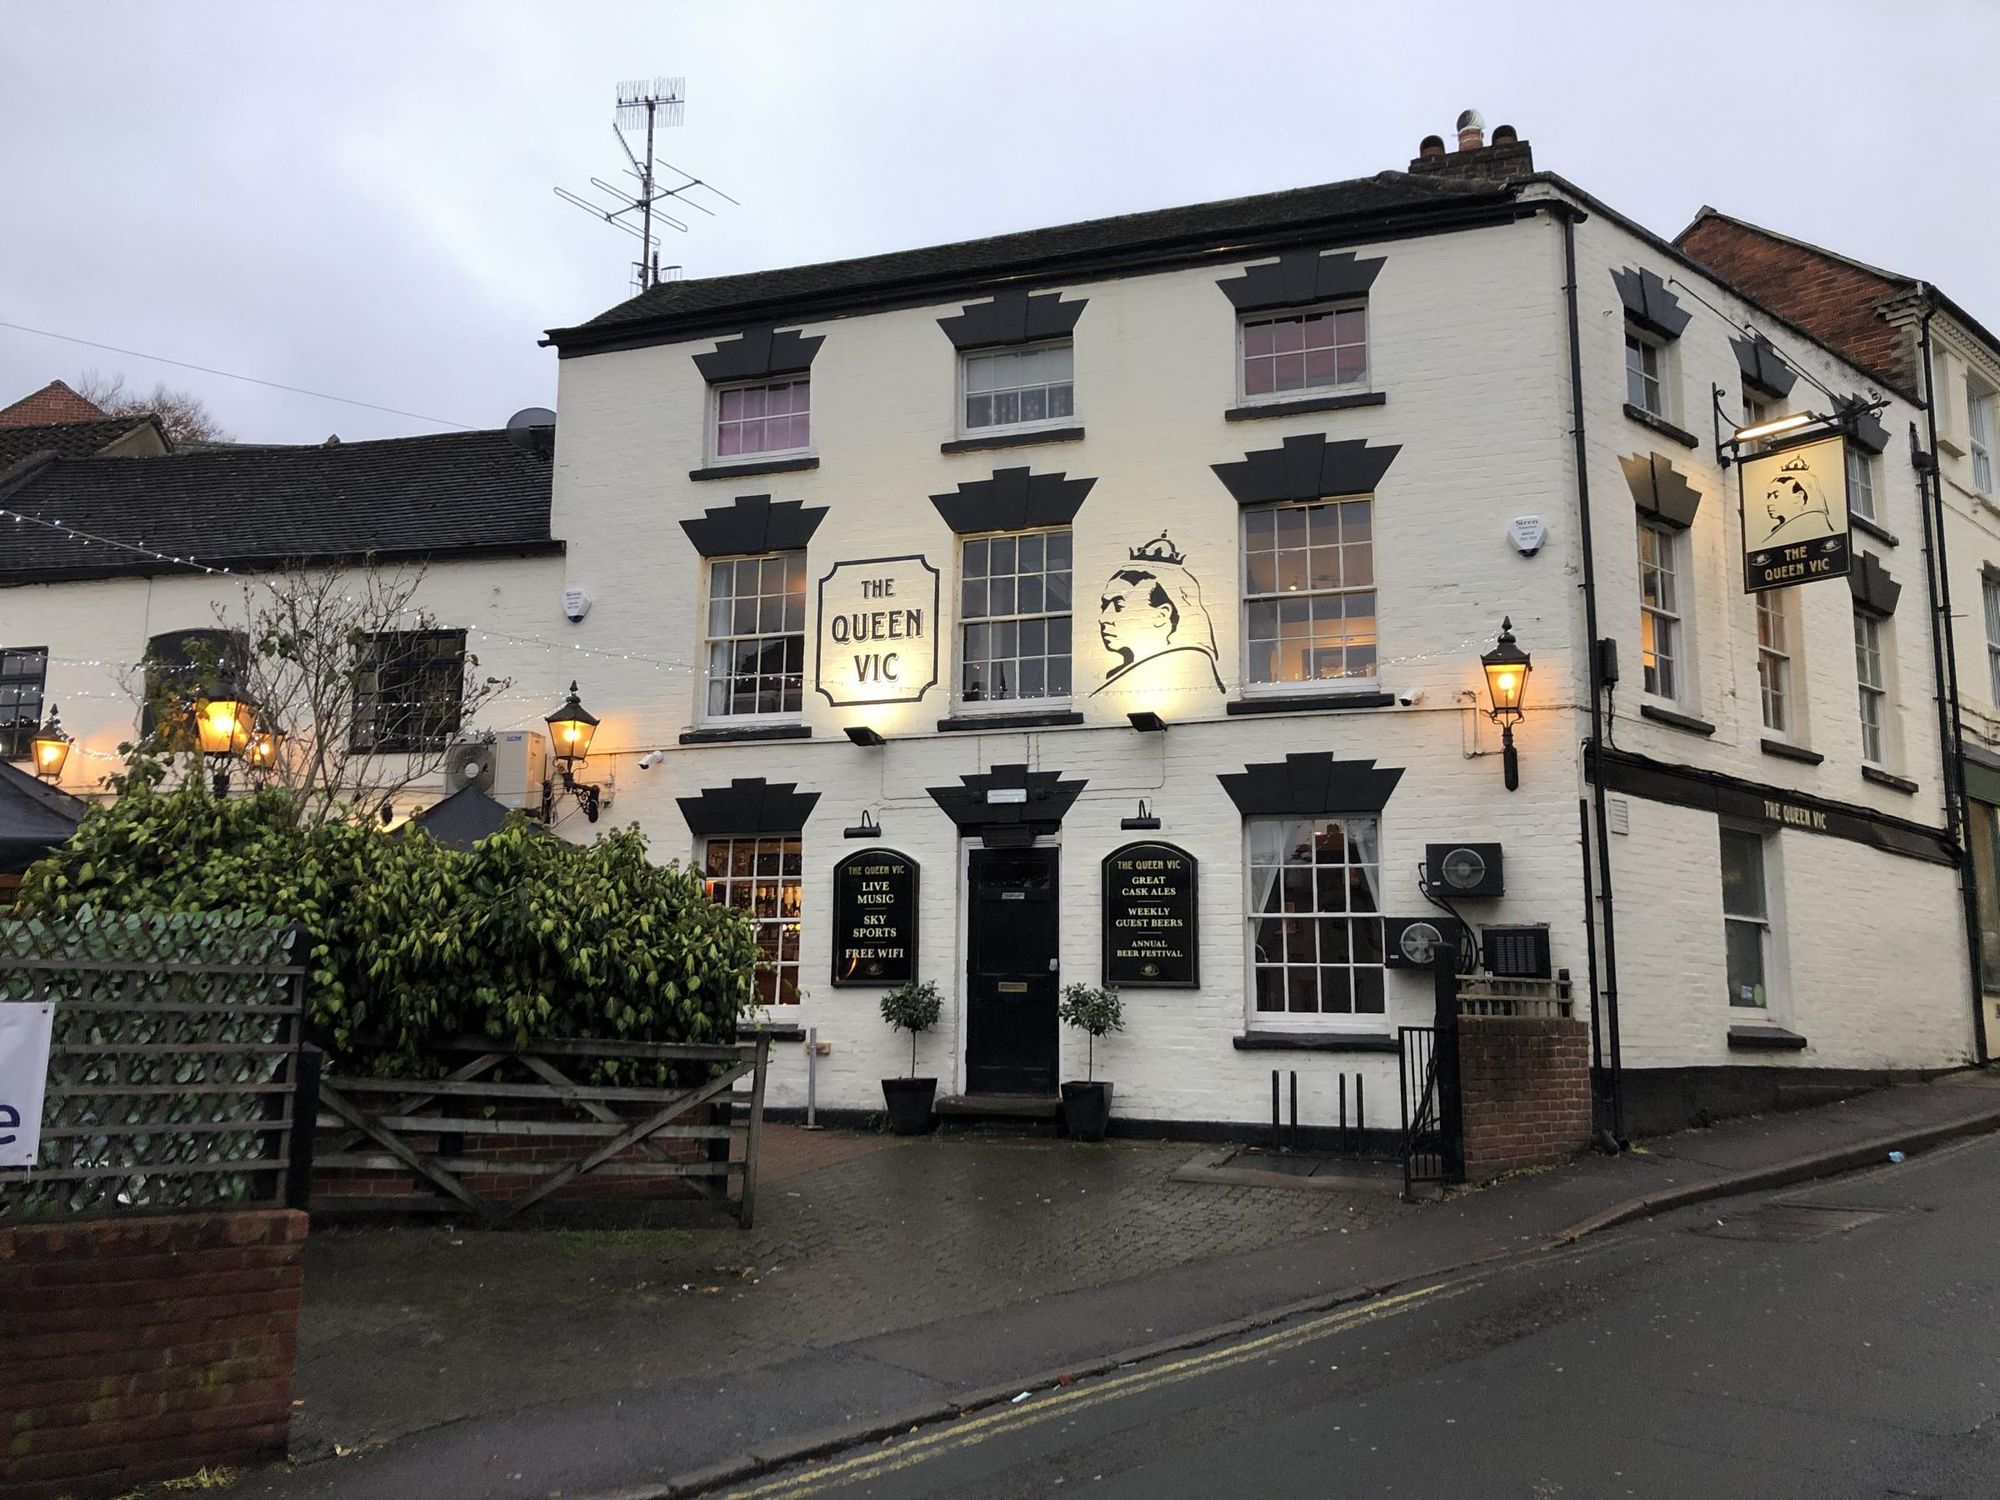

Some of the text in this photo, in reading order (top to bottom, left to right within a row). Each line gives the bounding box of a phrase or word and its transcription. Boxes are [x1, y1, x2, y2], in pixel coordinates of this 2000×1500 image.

[1784, 546, 1808, 561] THE
[1764, 558, 1830, 581] QUEEN VIC
[861, 579, 895, 599] THE
[832, 609, 923, 643] QUEEN
[854, 653, 898, 682] VIC
[1764, 800, 1827, 830] THE QUEEN VIC
[848, 865, 905, 875] THE QUEEN VIC
[1117, 860, 1181, 870] THE QUEEN VIC
[1131, 876, 1166, 885] GREAT
[862, 881, 890, 891] LIVE
[1121, 888, 1177, 896] CASK ALES
[857, 894, 895, 904] MUSIC
[1127, 907, 1170, 916] WEEKLY
[864, 915, 887, 925] SKY
[1115, 919, 1184, 927] GUEST BEERS
[852, 928, 897, 938] SPORTS
[1131, 940, 1169, 948] ANNUAL
[845, 948, 904, 959] FREE WIFI
